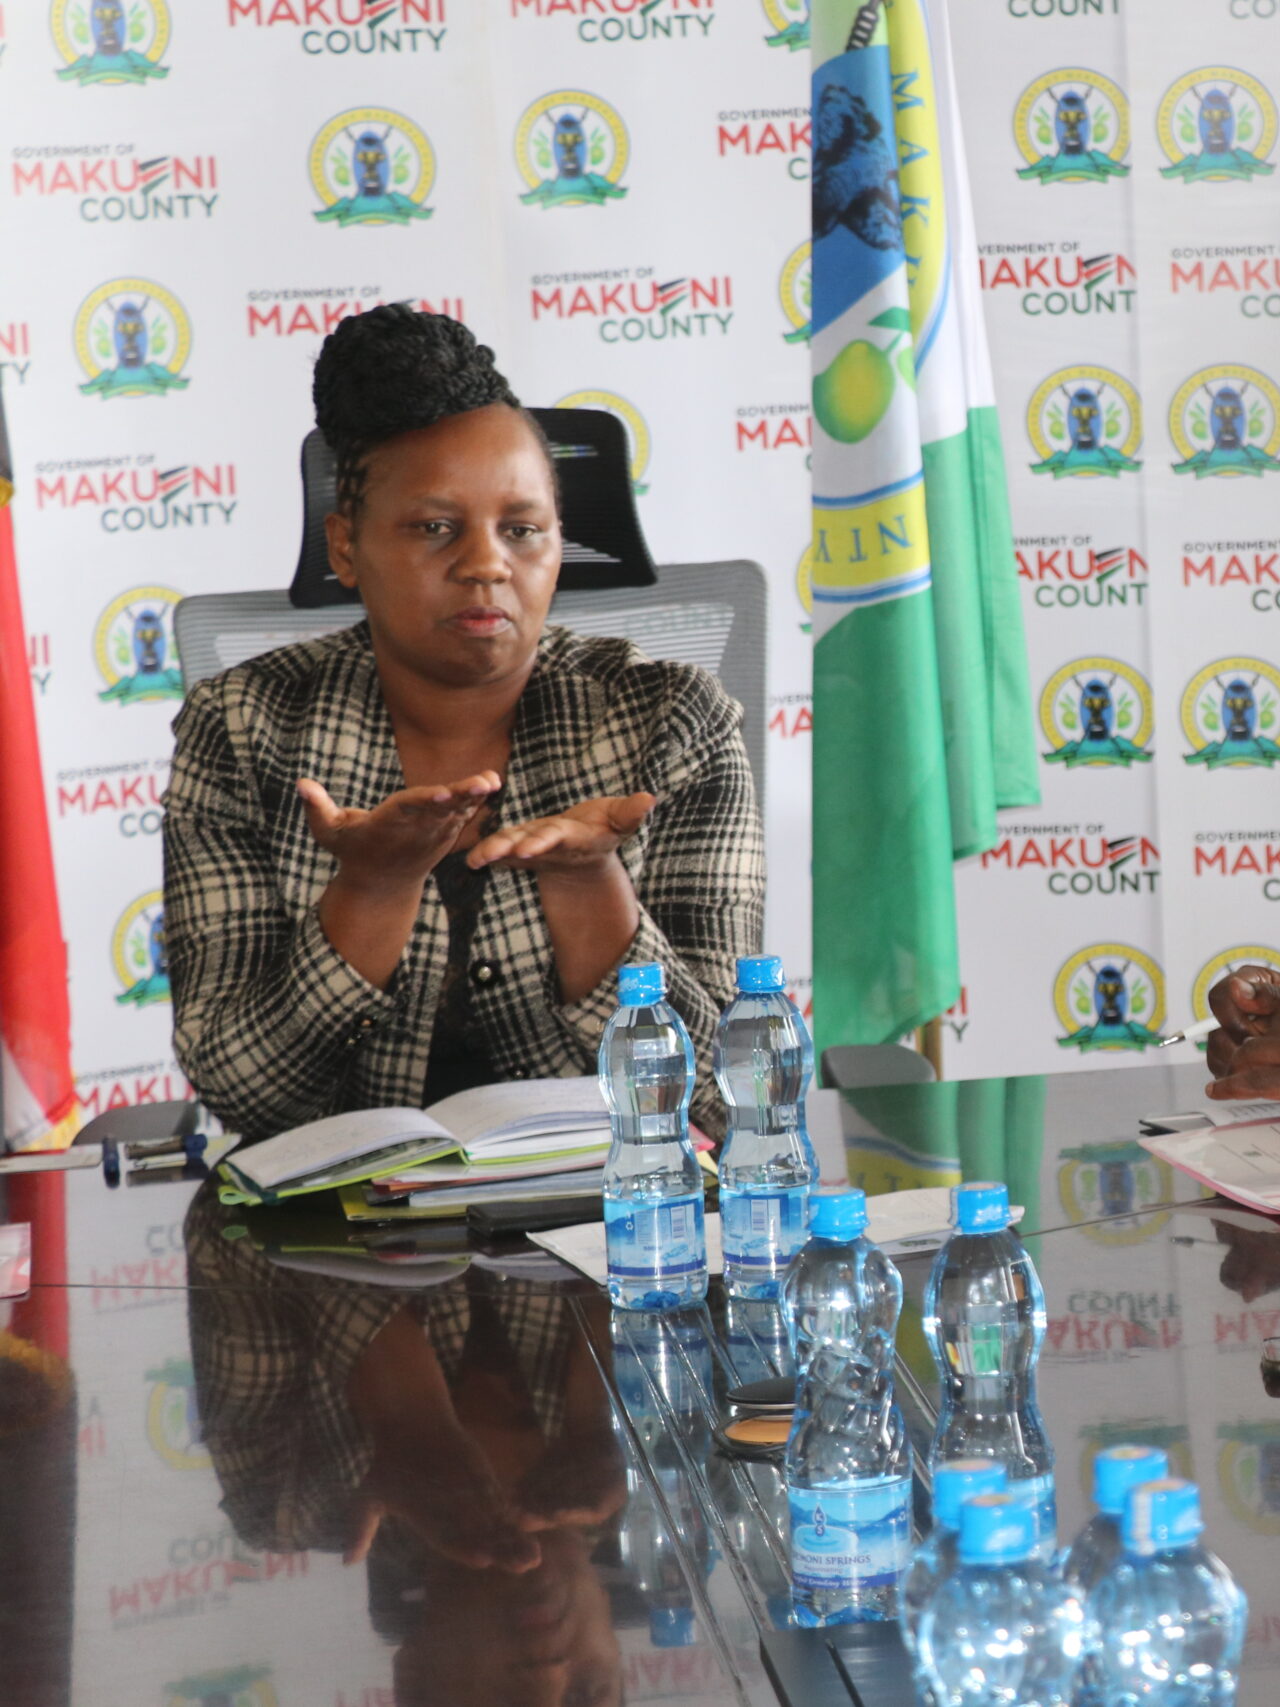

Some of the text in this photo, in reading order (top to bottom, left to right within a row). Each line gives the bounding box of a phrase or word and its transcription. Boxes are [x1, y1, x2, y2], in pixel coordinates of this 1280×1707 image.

[578, 13, 715, 43] COUNTY
[301, 28, 447, 55] COUNTY
[116, 144, 134, 155] OF
[12, 156, 217, 195] MAKUENI
[81, 193, 218, 222] COUNTY
[1060, 241, 1080, 253] OF
[1172, 244, 1275, 259] GOVERNMENT
[635, 267, 654, 278] OF
[360, 286, 381, 298] OF
[530, 276, 732, 320] MAKUENI
[599, 311, 733, 343] COUNTY
[139, 454, 155, 467] OF
[35, 464, 236, 507] MAKUENI
[102, 502, 237, 532] COUNTY
[1073, 535, 1092, 546] OF
[1086, 823, 1104, 835] OF
[825, 1553, 871, 1566] SPRINGS
